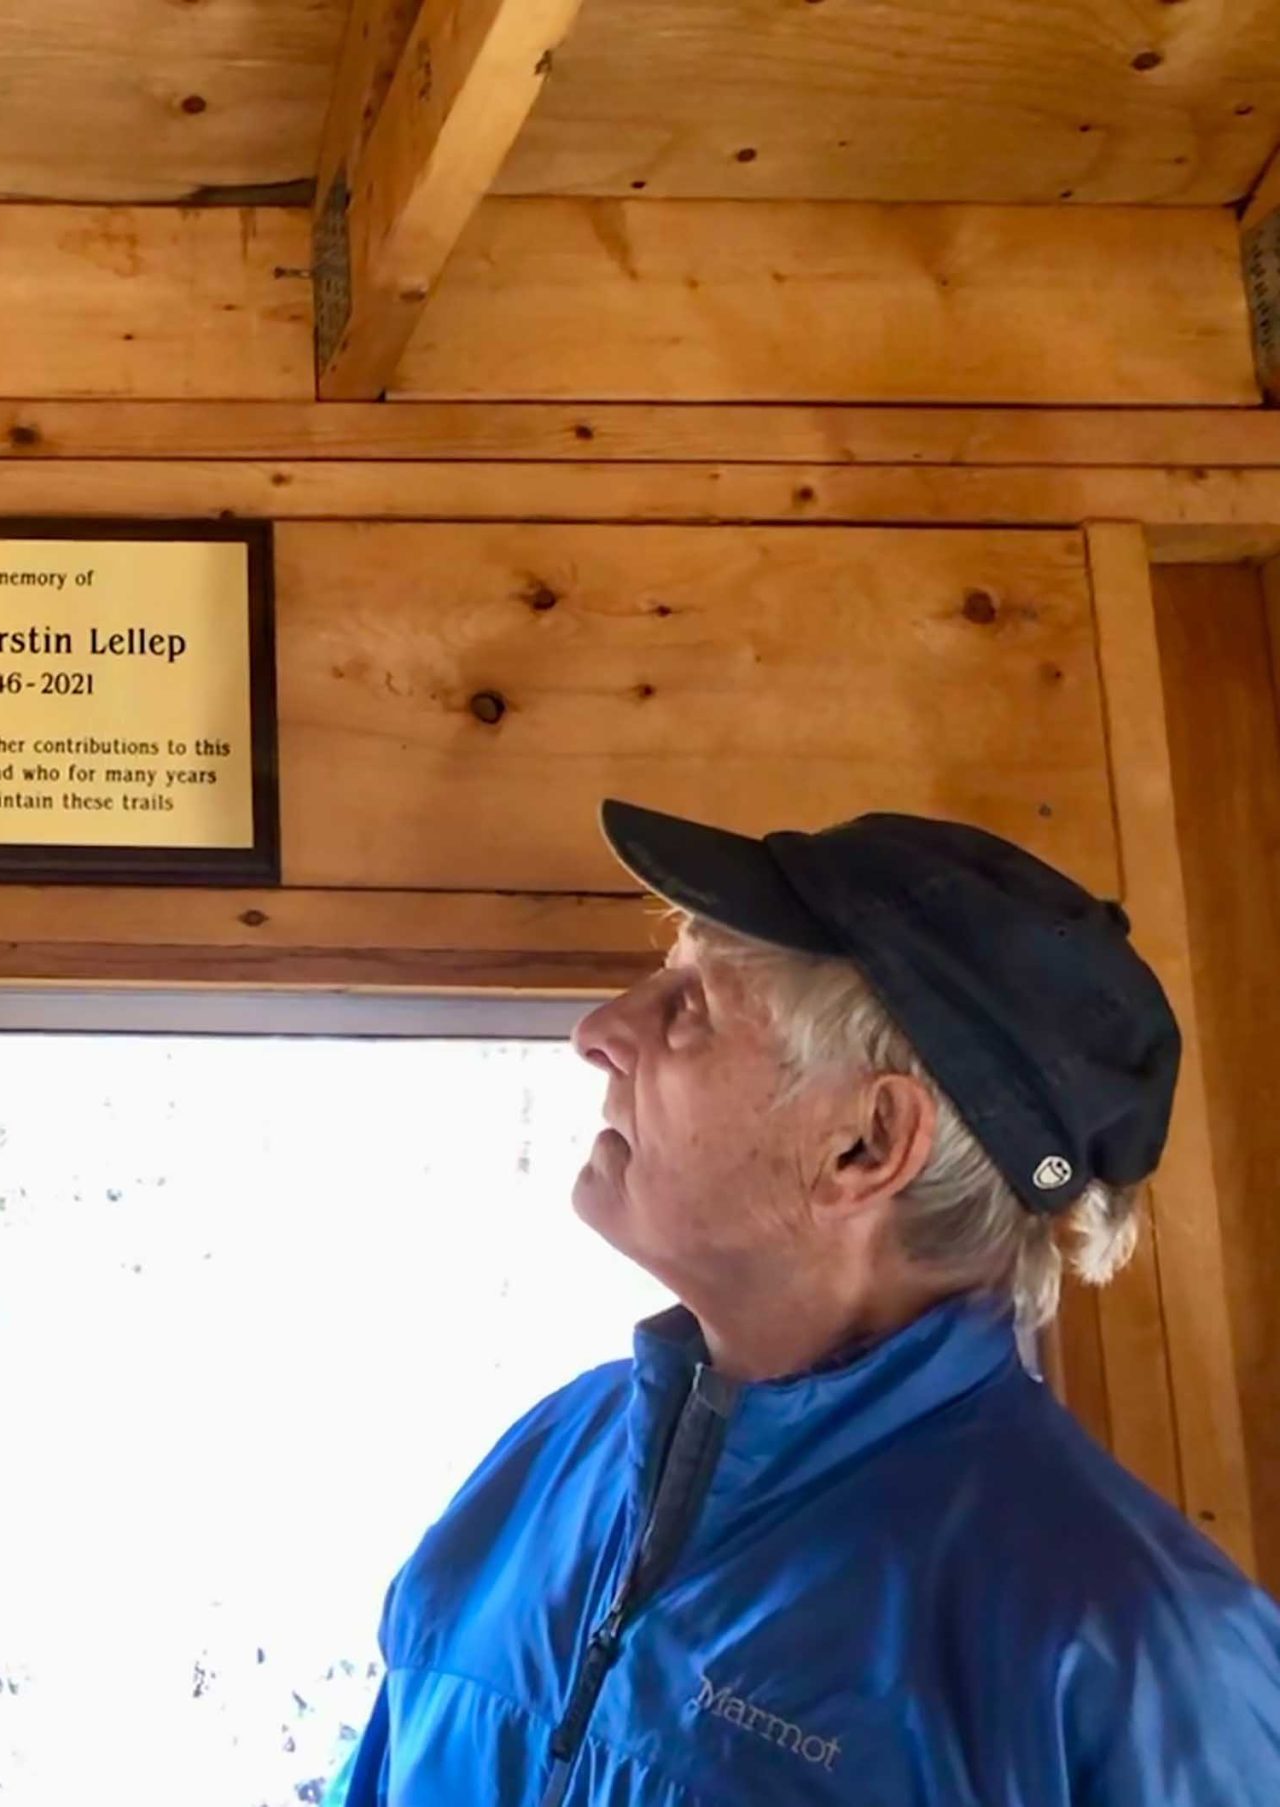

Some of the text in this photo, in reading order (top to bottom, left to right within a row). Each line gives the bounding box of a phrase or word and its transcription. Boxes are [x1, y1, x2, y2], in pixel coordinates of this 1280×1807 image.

[75, 569, 96, 587] of
[90, 627, 186, 663] Lellep
[33, 737, 160, 756] contributions
[167, 739, 187, 756] to
[194, 738, 232, 757] this
[22, 764, 60, 782] who
[68, 764, 96, 782] for
[105, 769, 156, 786] many
[166, 769, 218, 787] years
[63, 793, 114, 810] these
[122, 794, 174, 811] trails
[693, 1675, 841, 1771] Marmot
